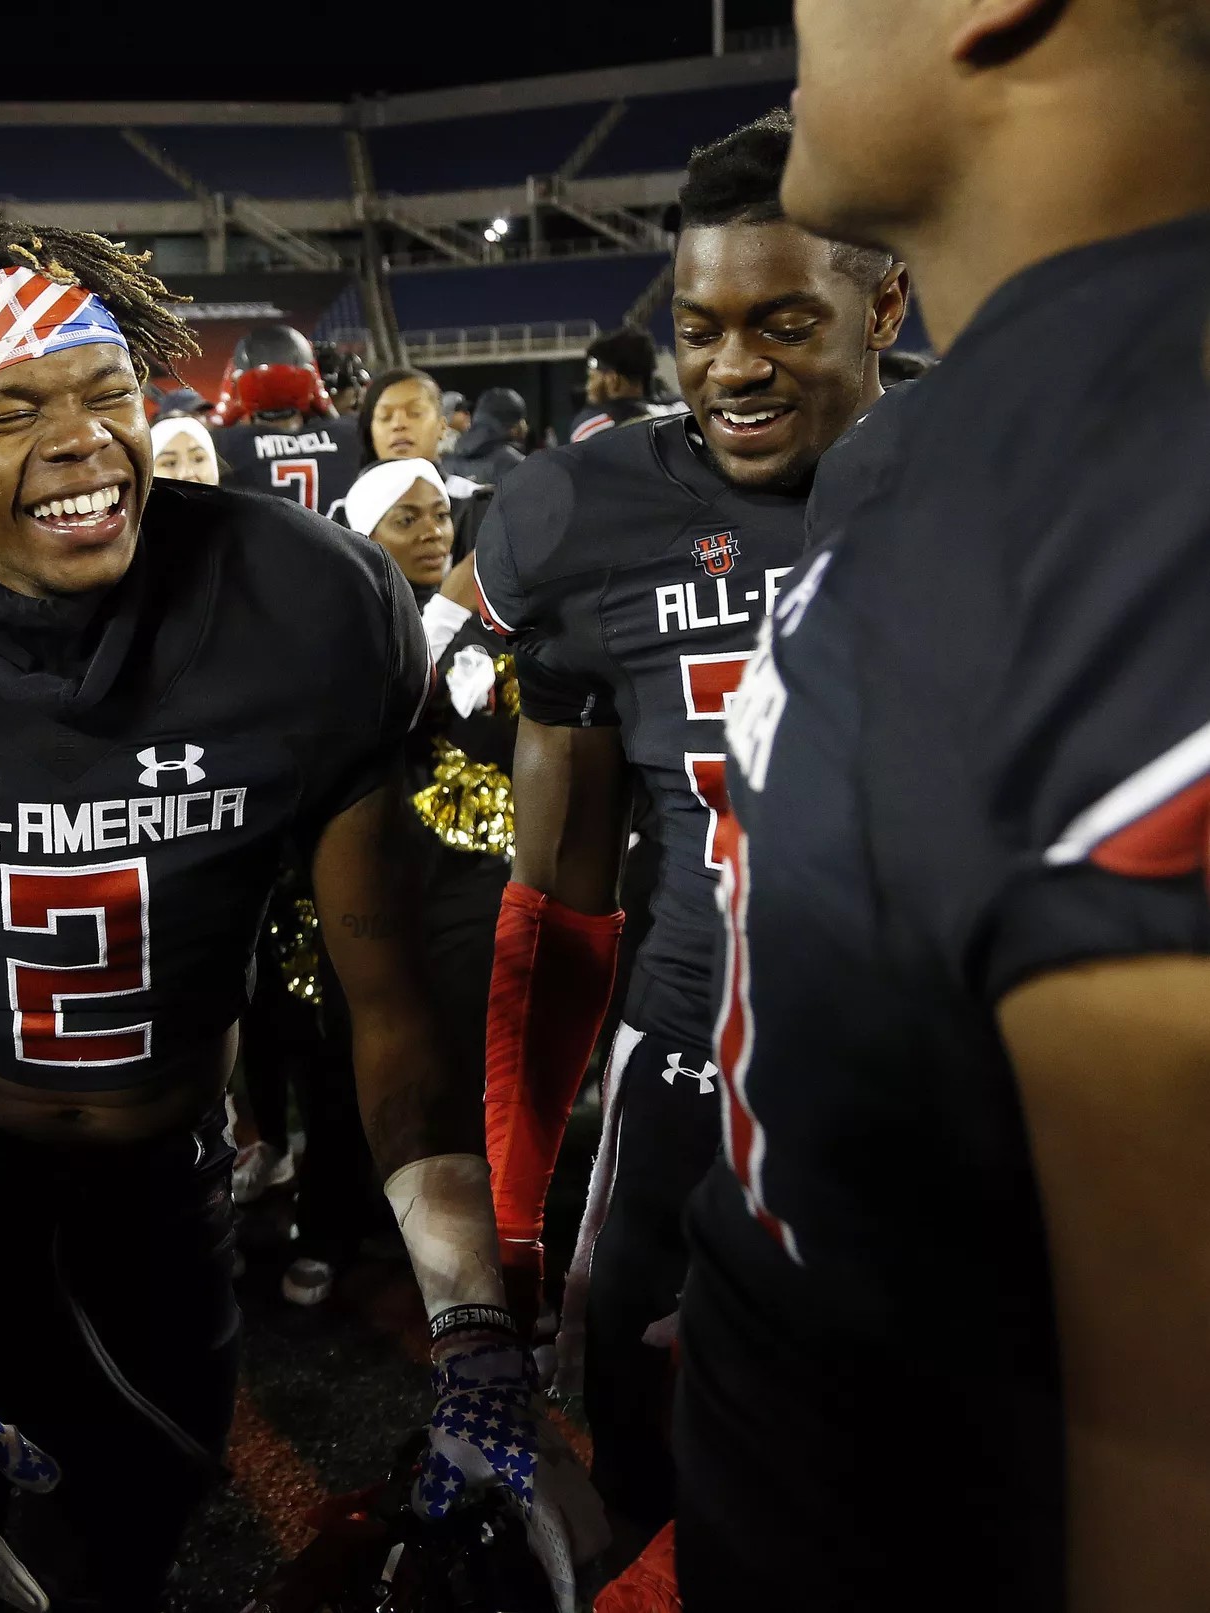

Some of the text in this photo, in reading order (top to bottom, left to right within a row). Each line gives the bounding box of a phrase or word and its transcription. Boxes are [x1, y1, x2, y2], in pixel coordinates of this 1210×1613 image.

[254, 430, 338, 459] MITCHELL
[270, 458, 319, 513] 7
[699, 544, 733, 561] ESPN
[0, 857, 152, 1068] 2
